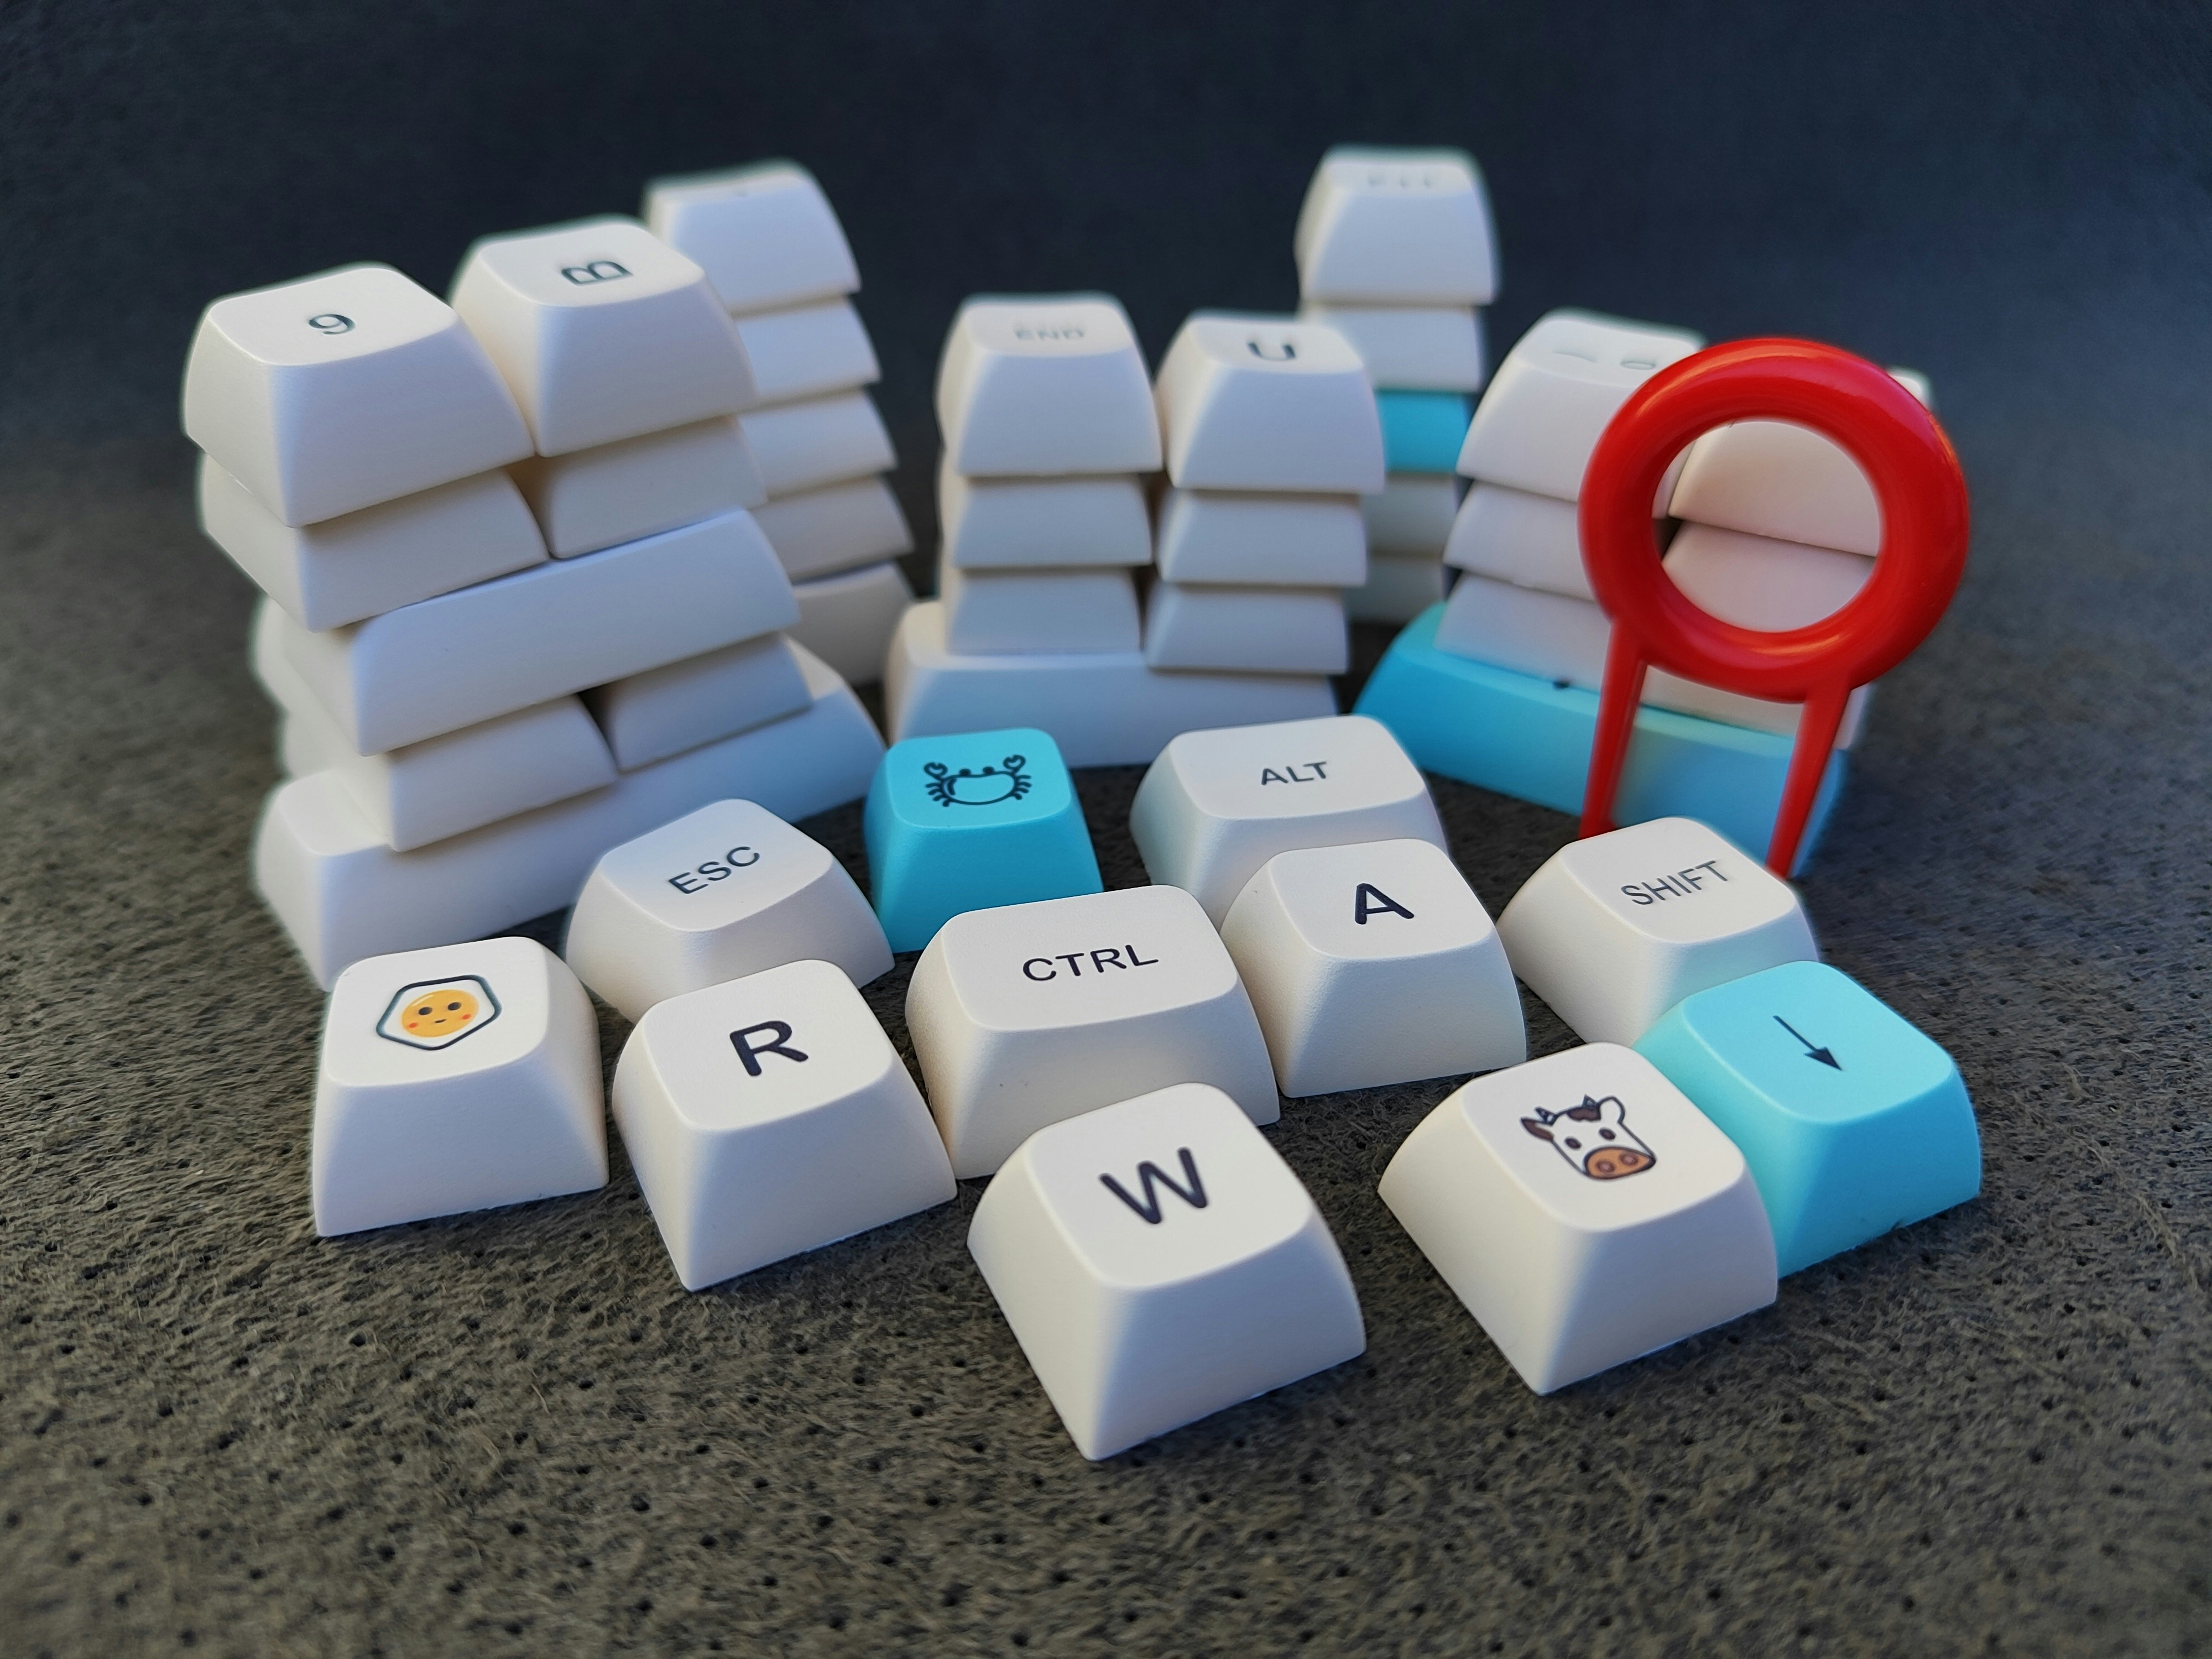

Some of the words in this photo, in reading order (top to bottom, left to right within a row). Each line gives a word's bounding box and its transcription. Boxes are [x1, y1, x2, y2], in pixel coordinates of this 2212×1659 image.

[561, 260, 633, 286] B
[308, 314, 356, 335] 9
[1246, 339, 1297, 361] U
[1261, 761, 1327, 786] ALT
[668, 846, 760, 894] ESC
[1621, 860, 1728, 905] SHIFT
[1354, 883, 1415, 925] A
[1022, 945, 1159, 982] CTRL
[729, 1020, 809, 1077] R
[1099, 1147, 1209, 1225] W
